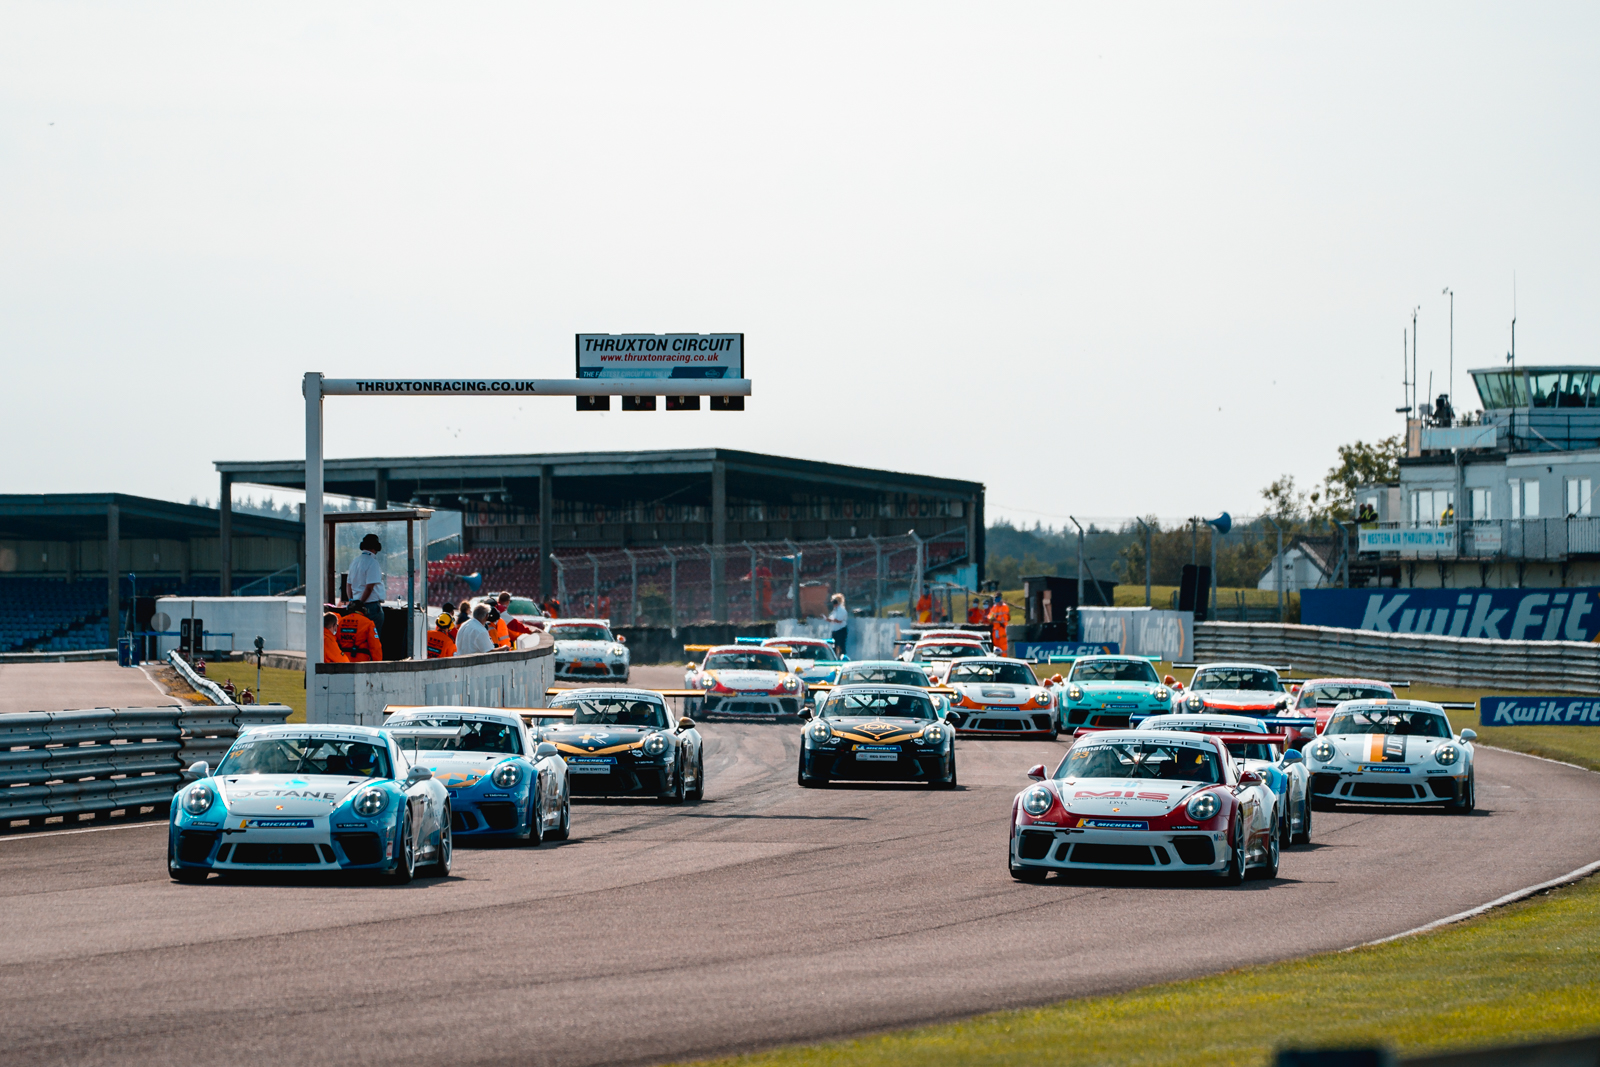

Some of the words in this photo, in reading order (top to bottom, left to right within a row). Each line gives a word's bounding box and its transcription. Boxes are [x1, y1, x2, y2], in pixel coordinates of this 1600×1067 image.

[585, 338, 668, 352] THRUXTON
[672, 338, 734, 352] CIRCUIT
[600, 352, 719, 364] www.thruxtonracing.co.uk
[356, 381, 535, 392] THRUXTONRACING.CO.UK
[402, 714, 502, 722] PORSCHE
[254, 733, 369, 742] PORSCHE
[1090, 738, 1200, 747] PORSCHE
[232, 743, 254, 752] King
[1074, 745, 1112, 754] Hanafin
[228, 750, 244, 760] 19
[1072, 752, 1090, 760] 23
[234, 790, 336, 800] OCTANE
[1074, 790, 1170, 800] MIS
